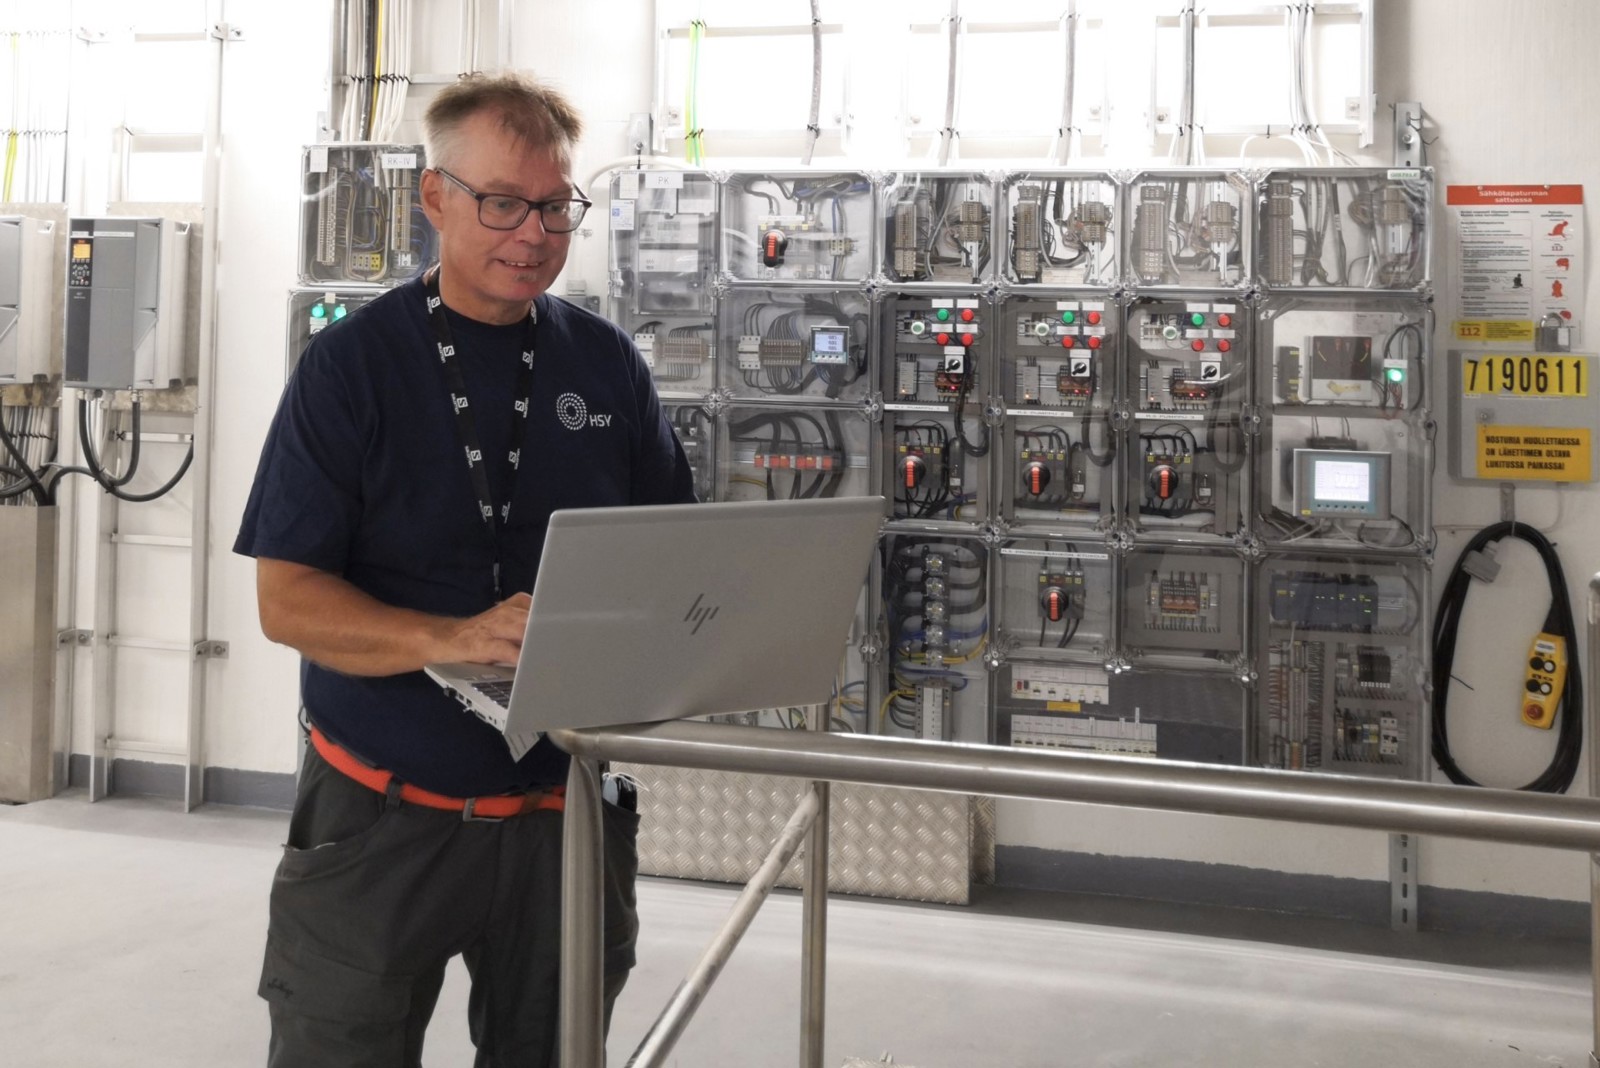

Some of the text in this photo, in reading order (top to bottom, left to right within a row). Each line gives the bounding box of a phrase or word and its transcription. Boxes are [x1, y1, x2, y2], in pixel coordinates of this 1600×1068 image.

[1460, 327, 1480, 336] 112
[1467, 357, 1581, 394] 7190611
[589, 414, 612, 427] HSY
[1485, 435, 1581, 446] NOSTURIA HUOLLETTAESSA
[1485, 447, 1571, 458] ON LÄHETTIMEN OLTAVA
[1485, 460, 1524, 469] LUKITUSSA
